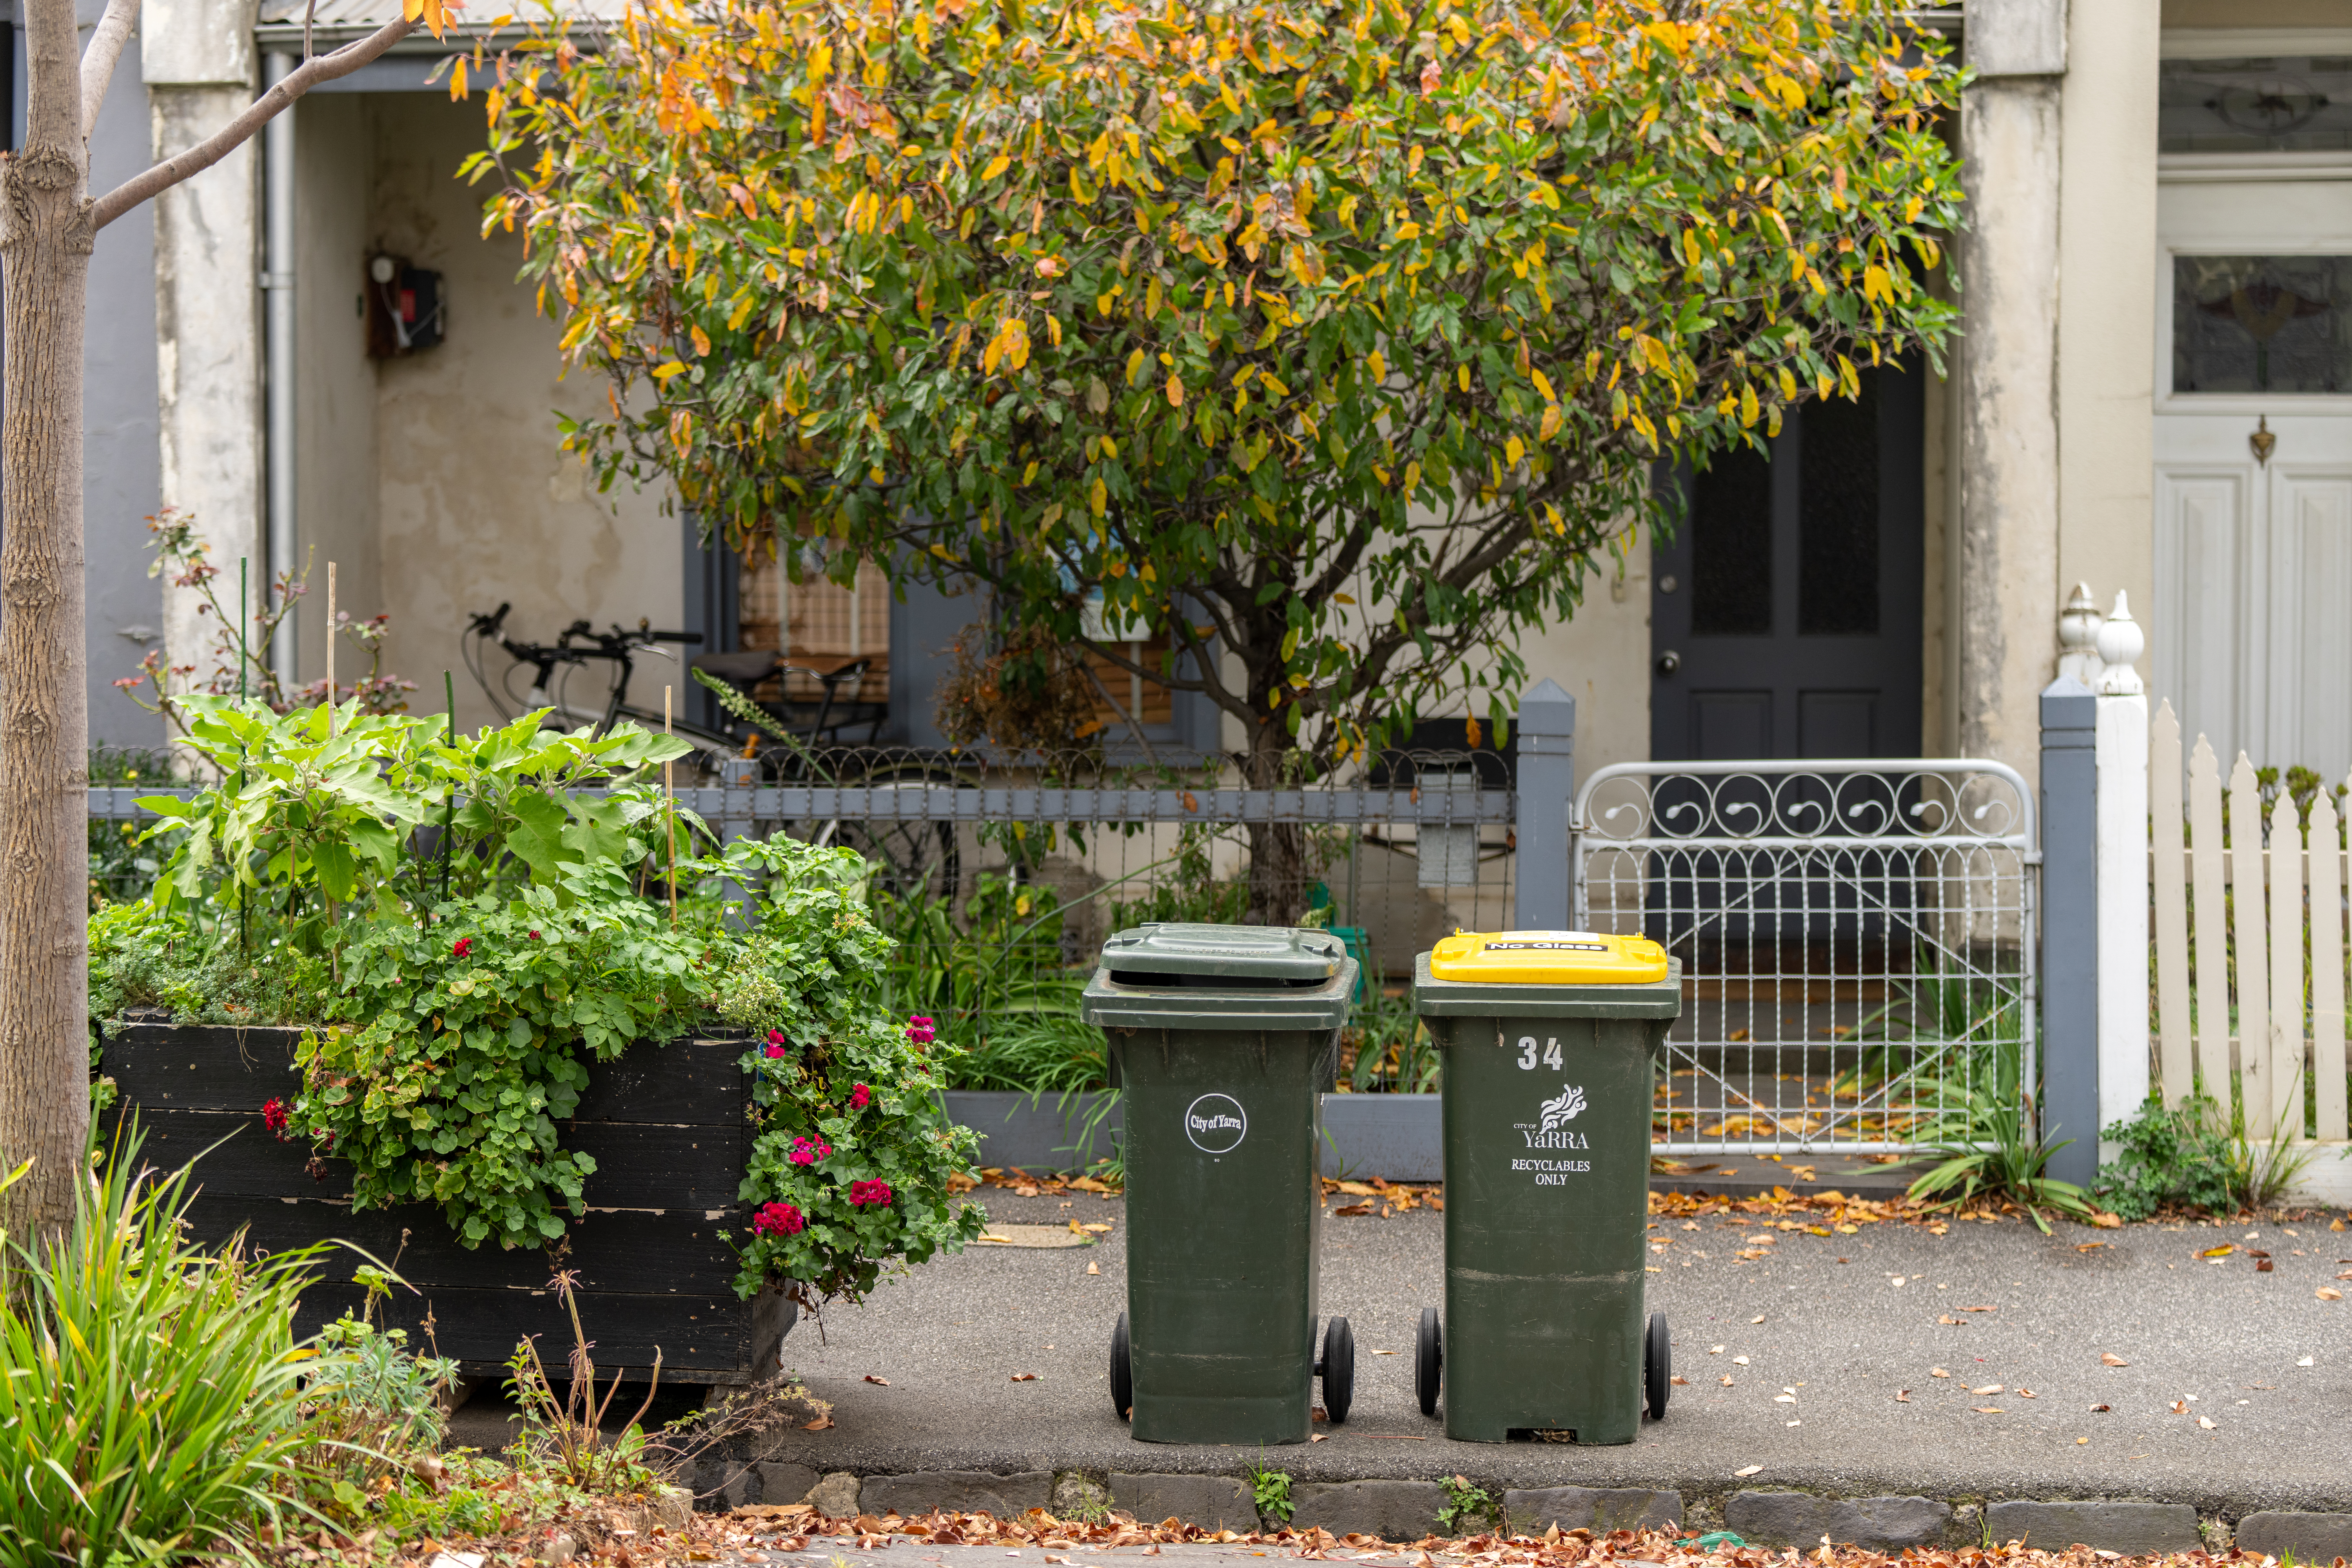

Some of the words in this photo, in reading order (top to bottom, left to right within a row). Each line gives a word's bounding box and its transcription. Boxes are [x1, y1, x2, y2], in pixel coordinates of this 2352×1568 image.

[1517, 1036, 1563, 1071] 34
[1191, 1114, 1208, 1132] City
[1208, 1115, 1218, 1129] of
[1218, 1114, 1241, 1130] Yarra
[1522, 1131, 1590, 1149] YaRRA
[1512, 1159, 1590, 1172] RECYCLABLES
[1535, 1174, 1568, 1185] ONLY
